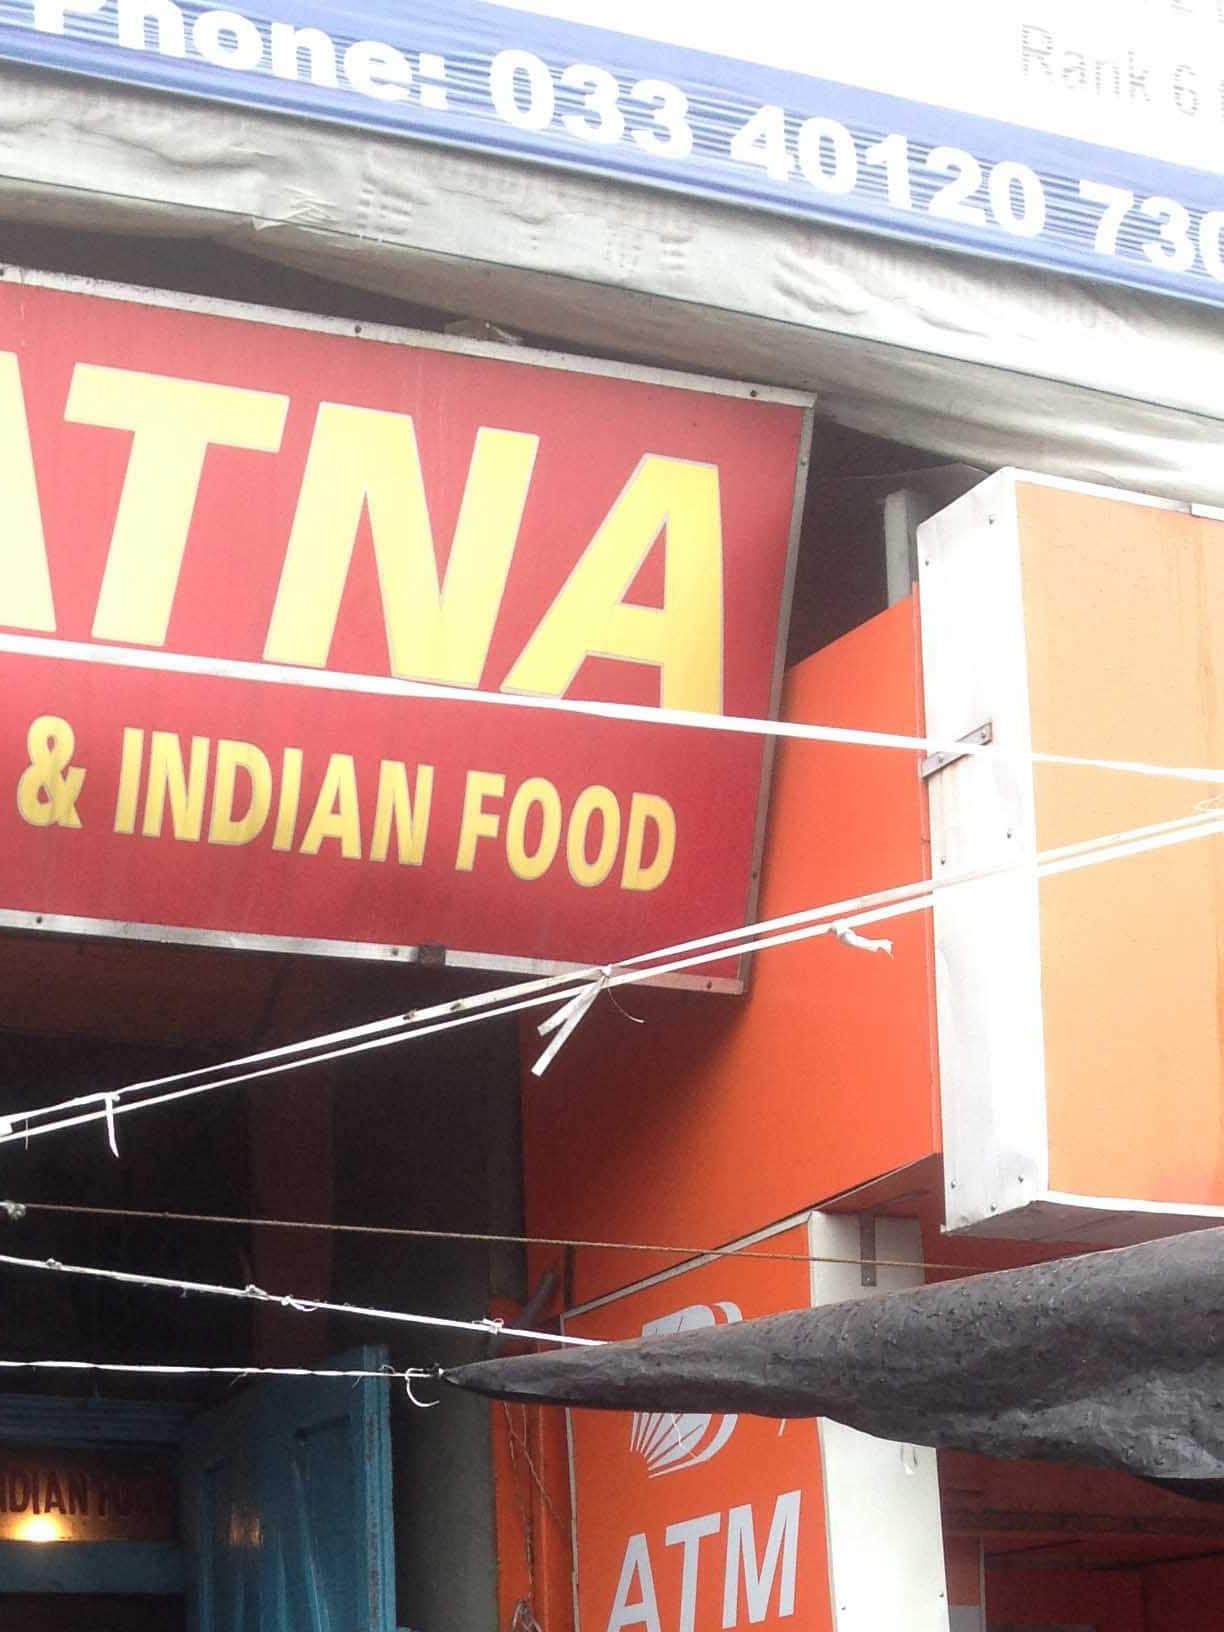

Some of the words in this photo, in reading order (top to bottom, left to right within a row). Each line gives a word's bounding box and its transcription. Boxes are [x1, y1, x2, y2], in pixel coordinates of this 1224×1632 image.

[489, 48, 695, 159] 033
[730, 104, 1047, 239] 40120
[1020, 23, 1151, 103] Rank
[1172, 64, 1200, 117] 6
[16, 715, 84, 828] &
[113, 725, 434, 867] INDIAN
[458, 767, 678, 894] FOOD
